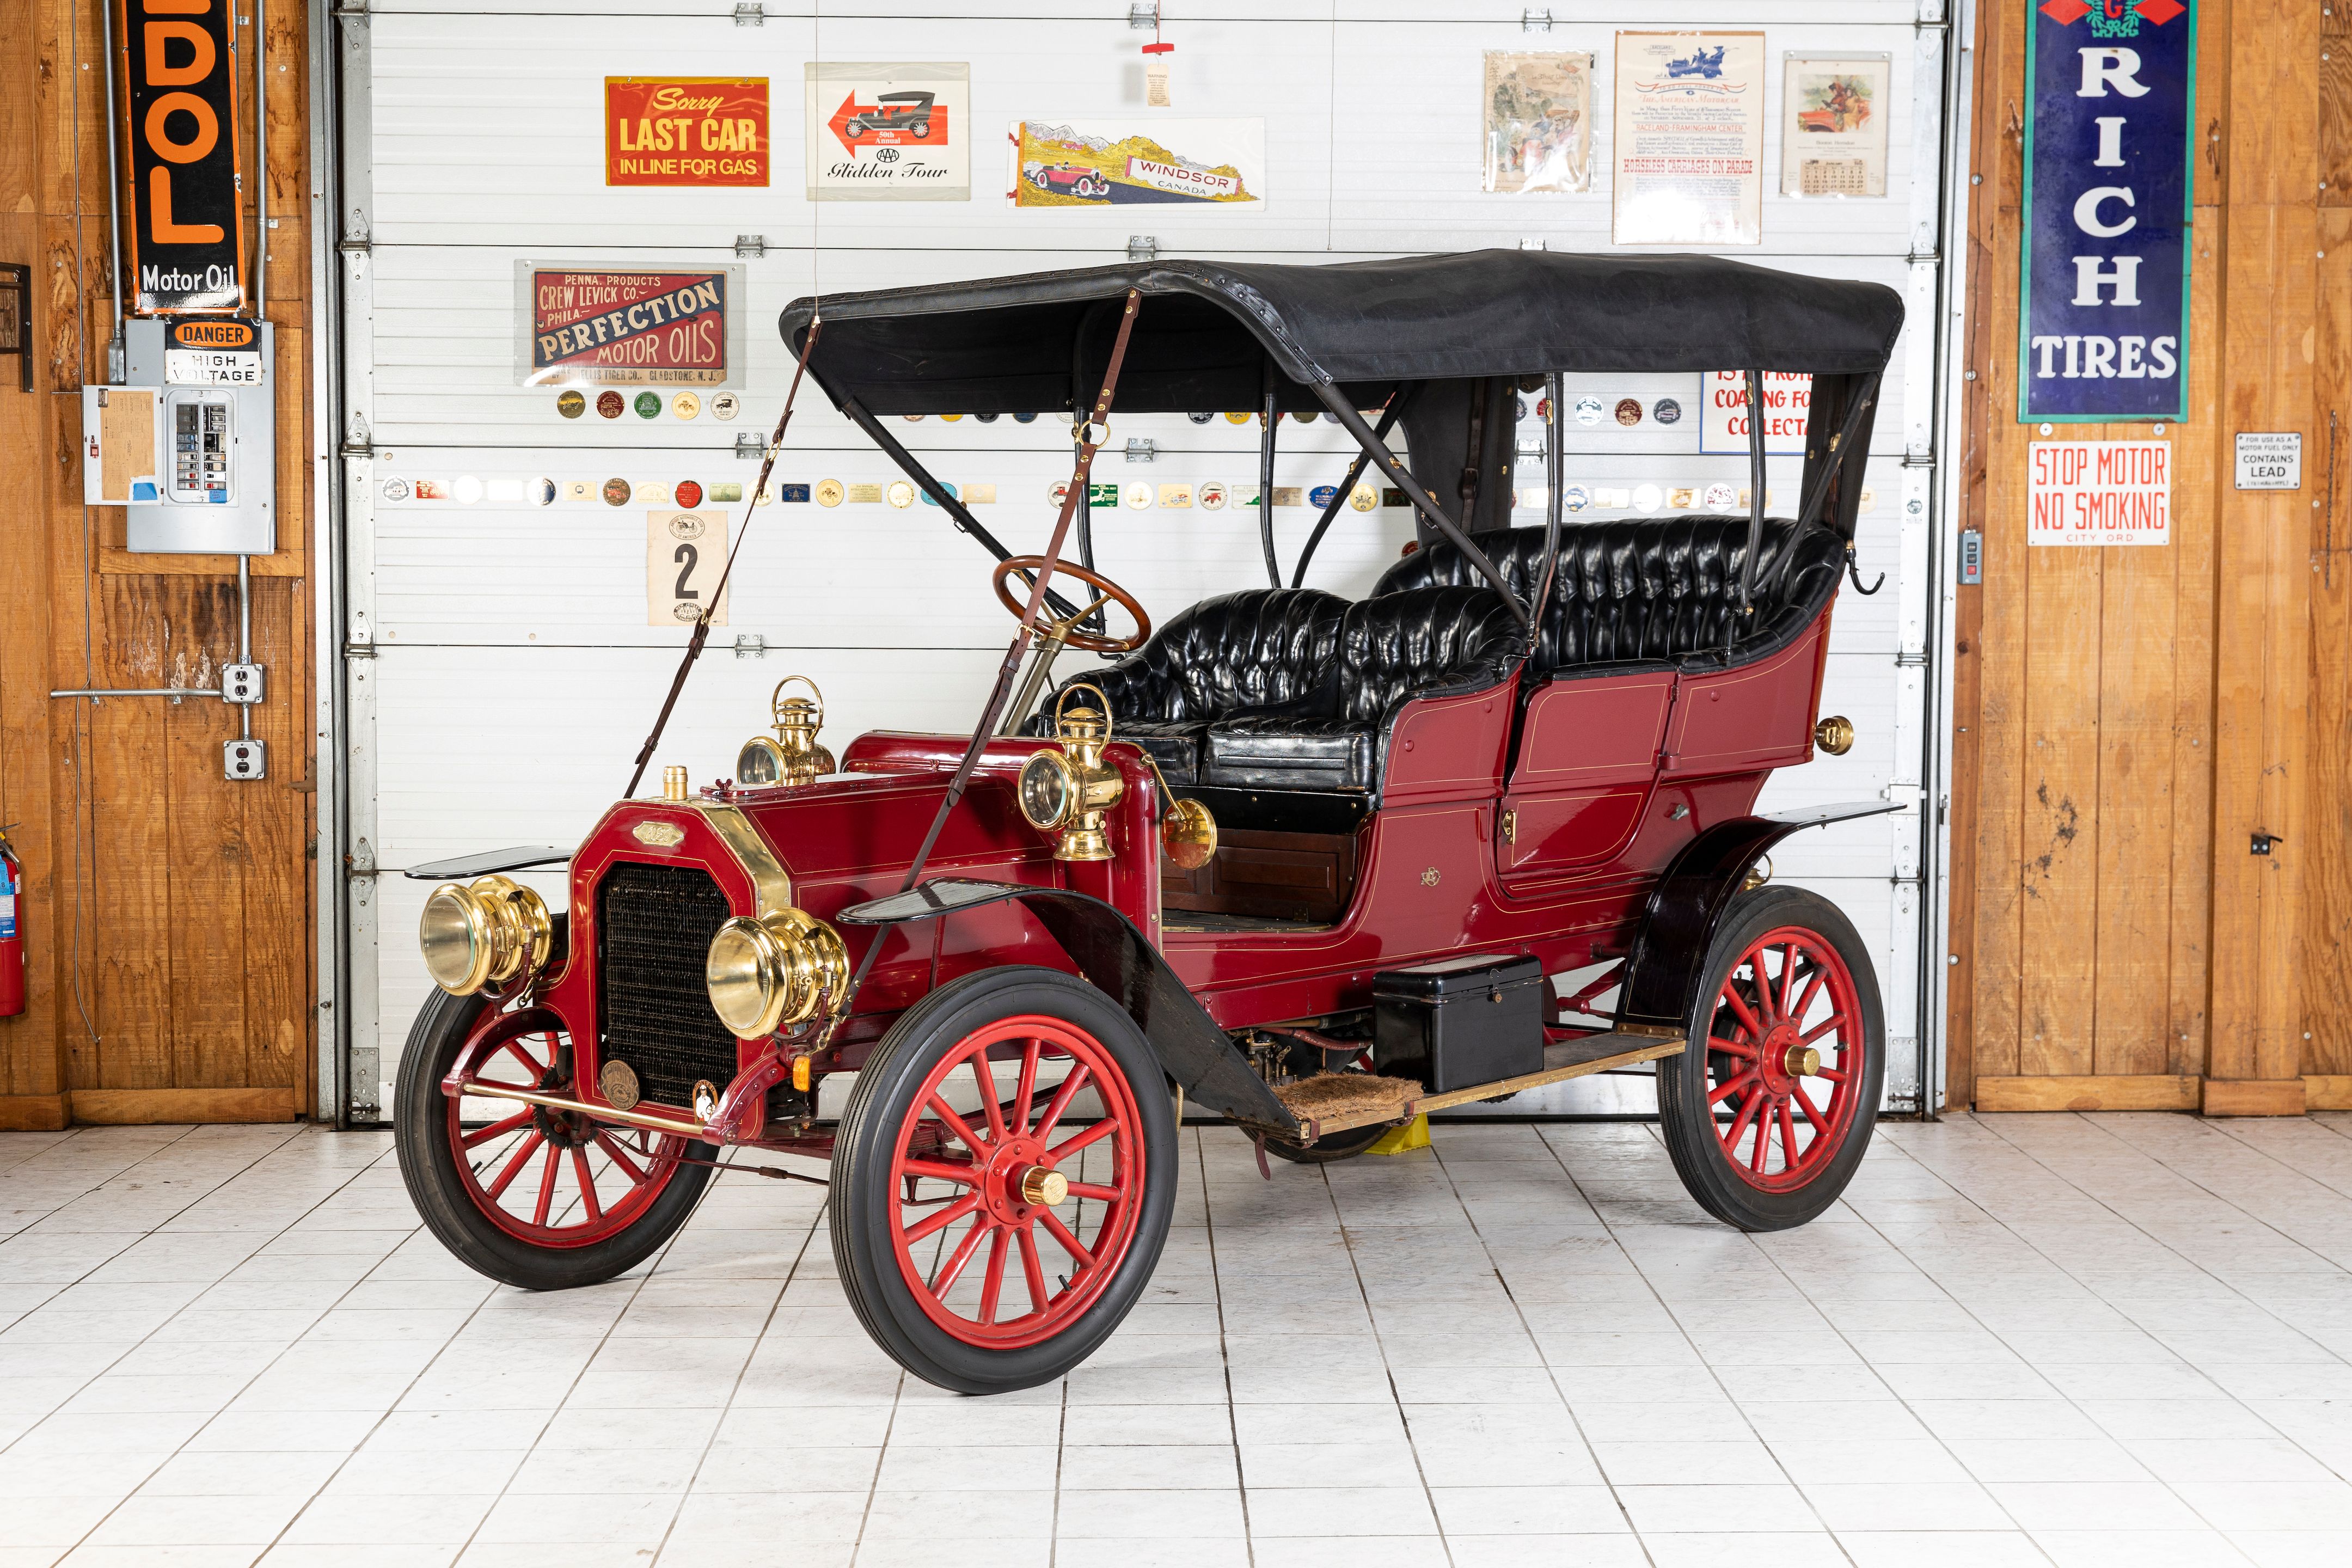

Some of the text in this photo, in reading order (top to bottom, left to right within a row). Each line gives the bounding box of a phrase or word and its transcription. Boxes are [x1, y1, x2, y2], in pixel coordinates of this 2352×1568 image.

[653, 88, 724, 118] Sorry
[143, 0, 224, 243] DOL
[620, 118, 757, 151] LAST CAR
[878, 149, 898, 162] AAA
[620, 158, 757, 175] IN LINE FOR GAS
[828, 163, 950, 178] Glidden Tour
[1141, 161, 1229, 188] WINDSOR
[1624, 159, 1753, 174] HORSELESS CARRIAGES ON PARADE
[2071, 47, 2151, 307] RICH
[1158, 180, 1206, 196] CANADA
[143, 264, 235, 292] Motor Oil
[565, 275, 660, 287] PENNA. PRODUCTS
[539, 285, 639, 311] CREW LEVICK CO.
[538, 281, 720, 361] PERFECTION
[548, 311, 583, 327] PHILA.
[183, 326, 244, 343] DANGER
[596, 319, 716, 364] MOTOR OILS
[192, 356, 236, 366] HIGH
[2031, 335, 2177, 380] TIRES
[605, 370, 626, 380] TIGER
[1715, 389, 1811, 408] COANG FO
[2035, 447, 2165, 487] STOP MOTOR
[2243, 455, 2293, 463] CONTAINS
[2251, 467, 2286, 477] LEAD
[2035, 492, 2165, 530] NO SMOKING
[2066, 533, 2098, 542] CITY
[675, 543, 699, 599] 2
[674, 611, 694, 622] AUTOMOBILE
[645, 826, 672, 842] REO
[694, 1080, 715, 1092] PIONEER
